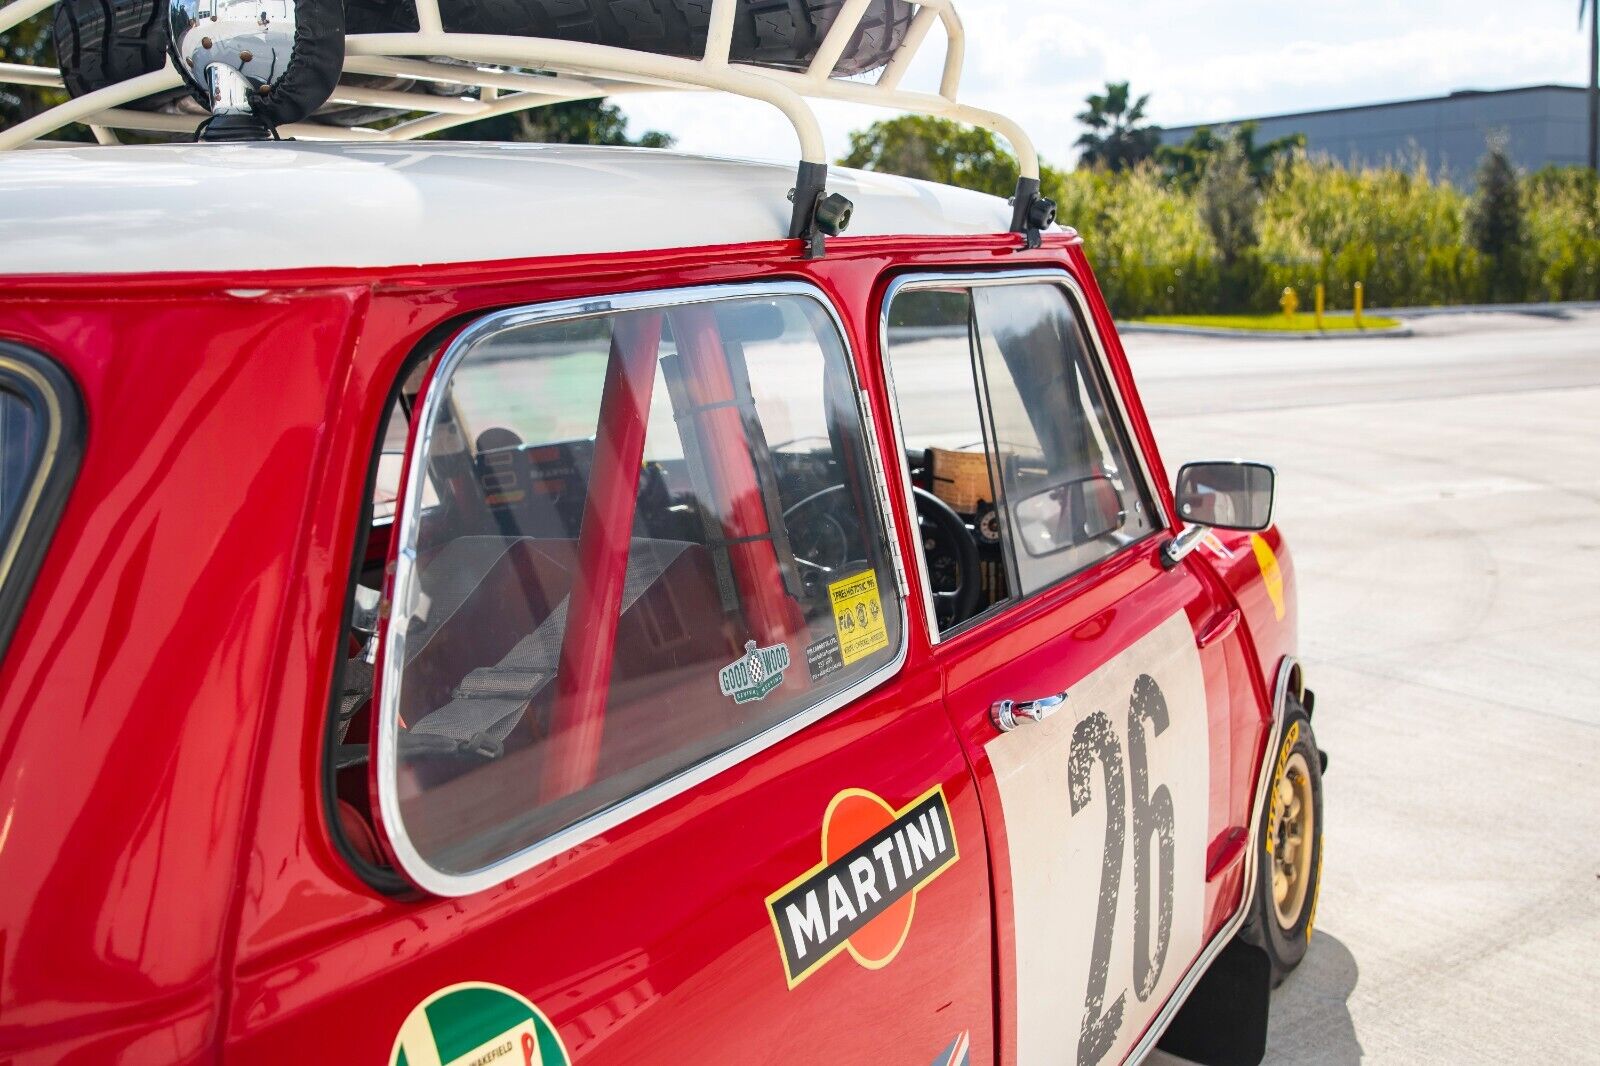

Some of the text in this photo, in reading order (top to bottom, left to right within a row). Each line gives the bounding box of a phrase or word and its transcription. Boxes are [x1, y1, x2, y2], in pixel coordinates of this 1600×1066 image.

[722, 662, 748, 691] GOOD
[762, 646, 788, 676] WOOD
[785, 806, 947, 960] MARTINI
[1068, 673, 1175, 1066] 26
